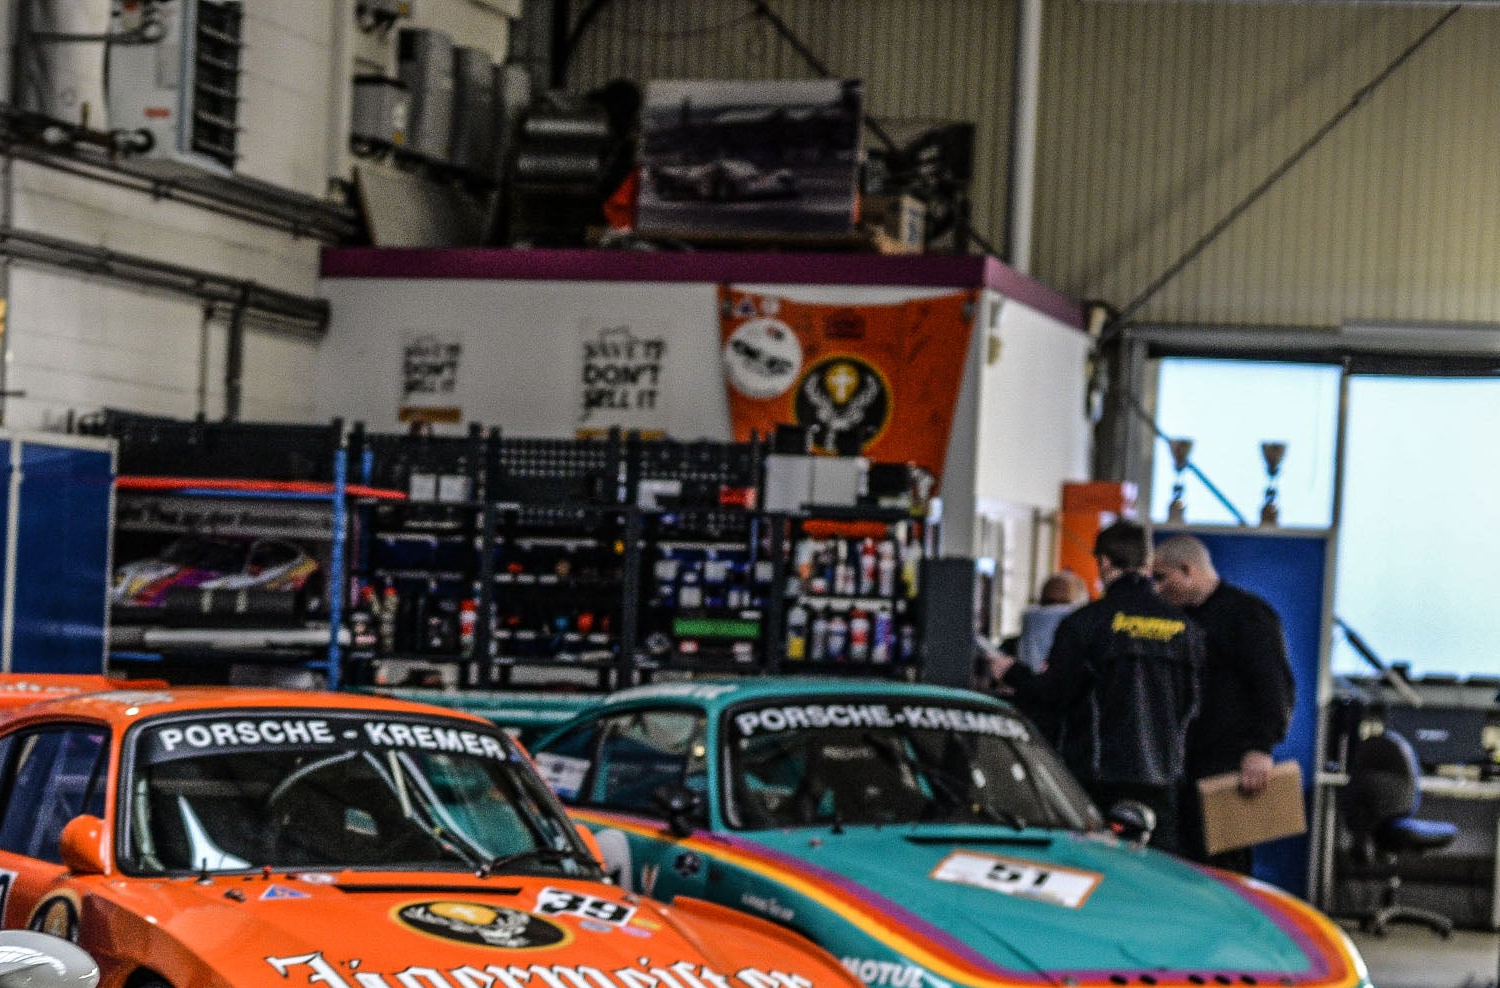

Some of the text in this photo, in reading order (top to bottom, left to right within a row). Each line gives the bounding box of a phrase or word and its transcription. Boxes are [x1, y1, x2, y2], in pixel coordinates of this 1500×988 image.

[583, 363, 659, 385] DON'T
[736, 704, 894, 736] PORSCHE
[903, 705, 1030, 742] KREMER
[159, 720, 335, 750] PORSCHE
[364, 721, 507, 760] KREMER
[986, 862, 1051, 887] 51
[540, 889, 631, 922] 39
